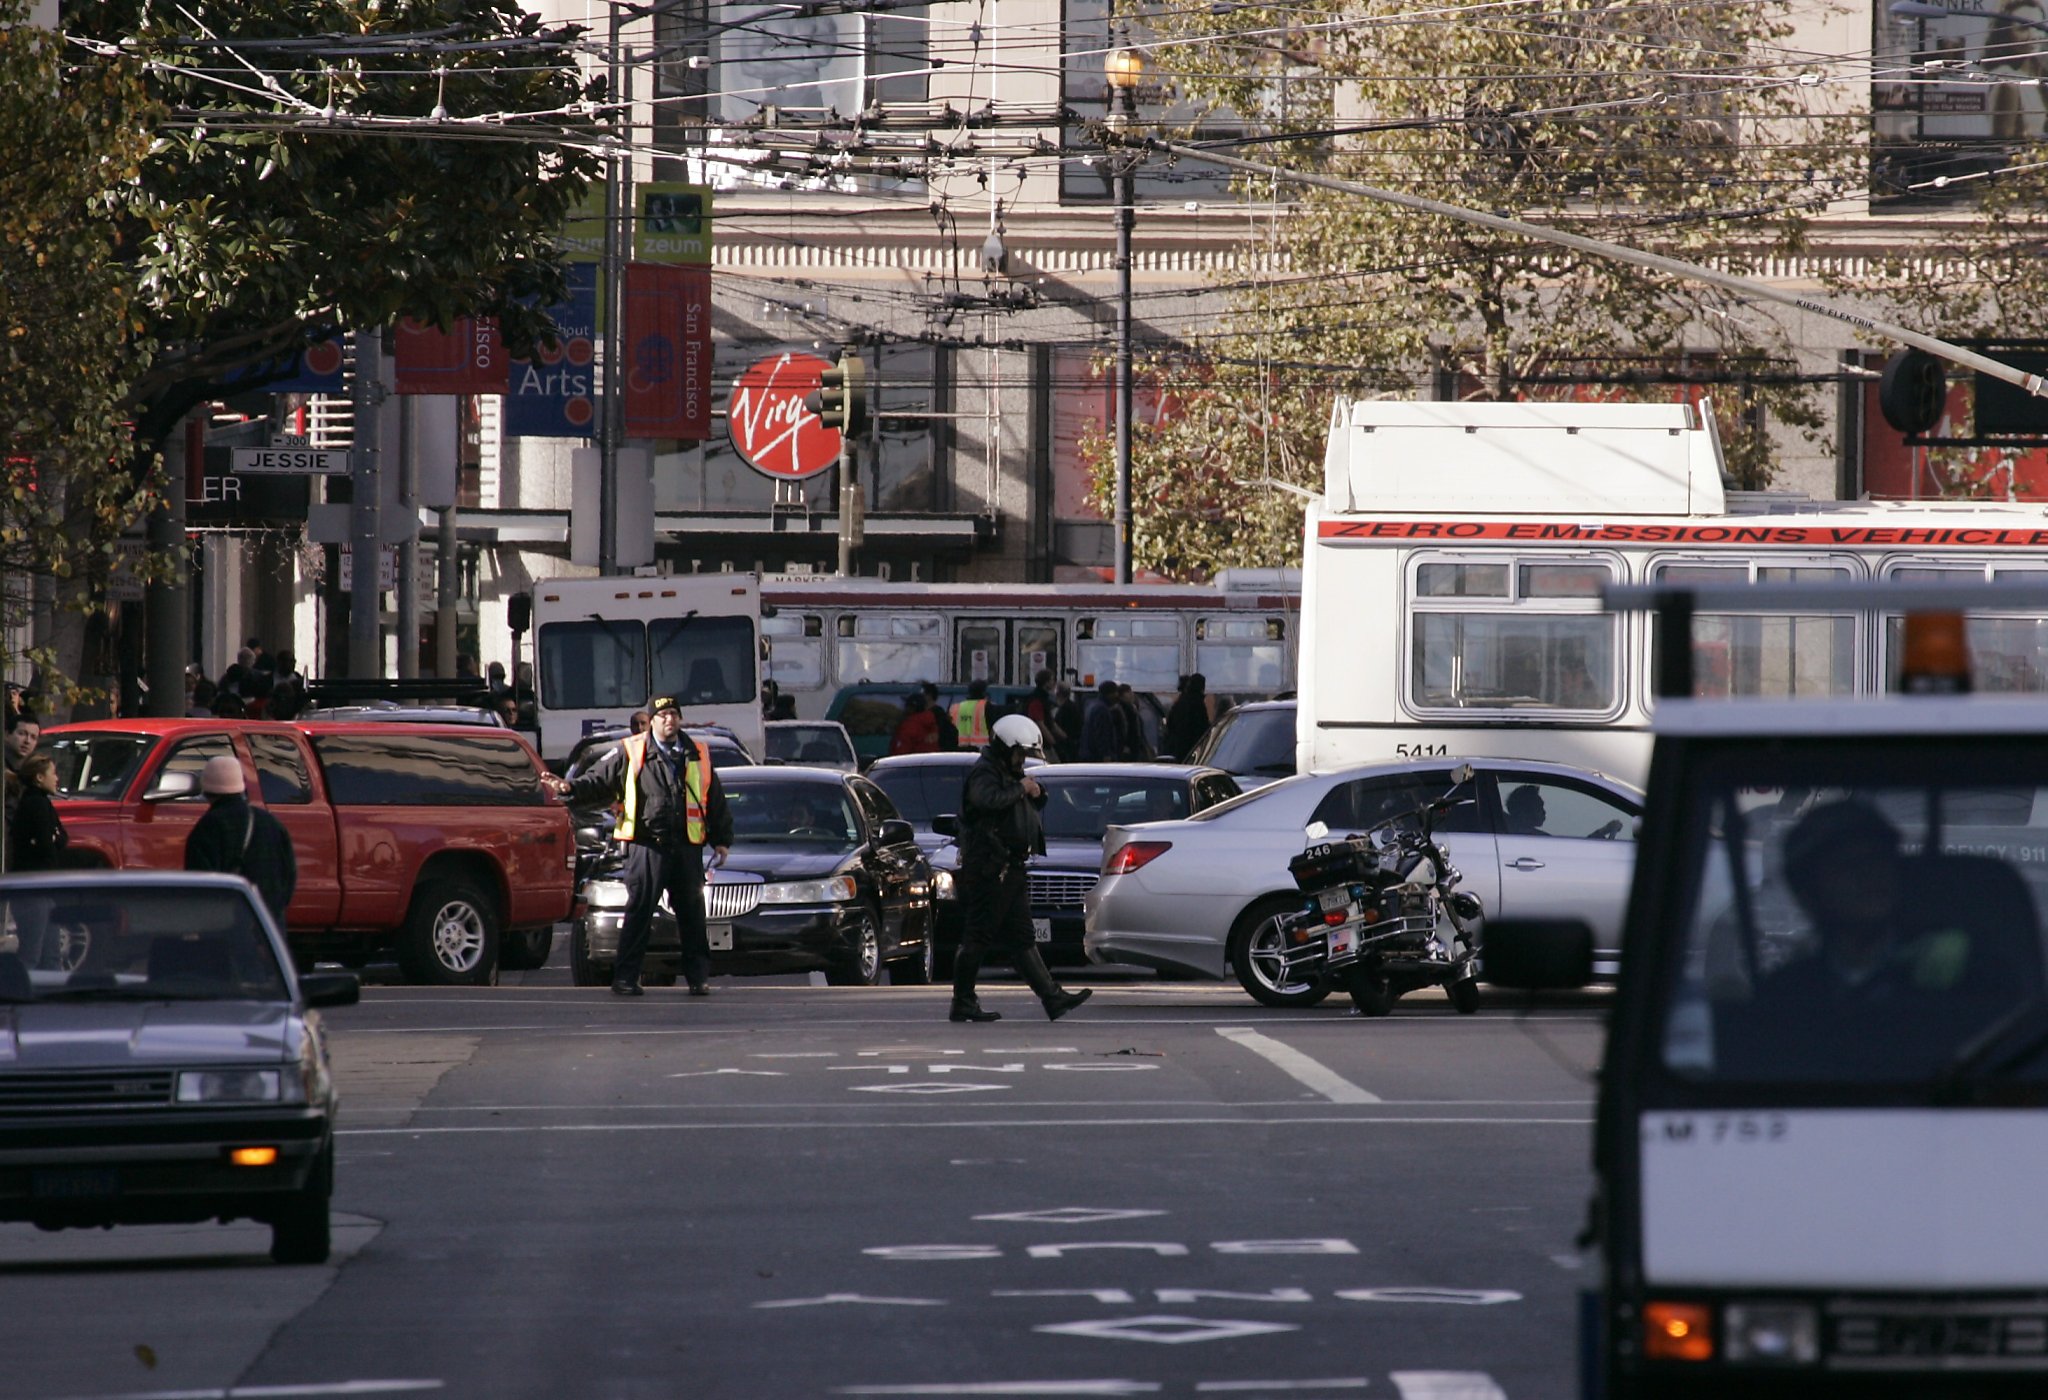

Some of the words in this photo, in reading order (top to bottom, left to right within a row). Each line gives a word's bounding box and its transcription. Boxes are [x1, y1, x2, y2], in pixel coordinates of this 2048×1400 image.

[643, 238, 702, 254] zeum
[686, 303, 702, 334] San
[1795, 299, 1826, 314] KIEPE
[1827, 309, 1876, 330] ELEKTRIK
[558, 322, 589, 338] hout
[518, 366, 587, 396] Arts
[686, 341, 702, 420] Francisco
[732, 353, 821, 471] Virg
[248, 453, 330, 468] JESSIE
[203, 476, 241, 501] ER
[1333, 522, 1486, 538] ZERO
[1504, 523, 1809, 543] EMISSIONS
[655, 698, 674, 708] DPT
[1396, 744, 1447, 757] 5414
[1306, 844, 1331, 860] 246
